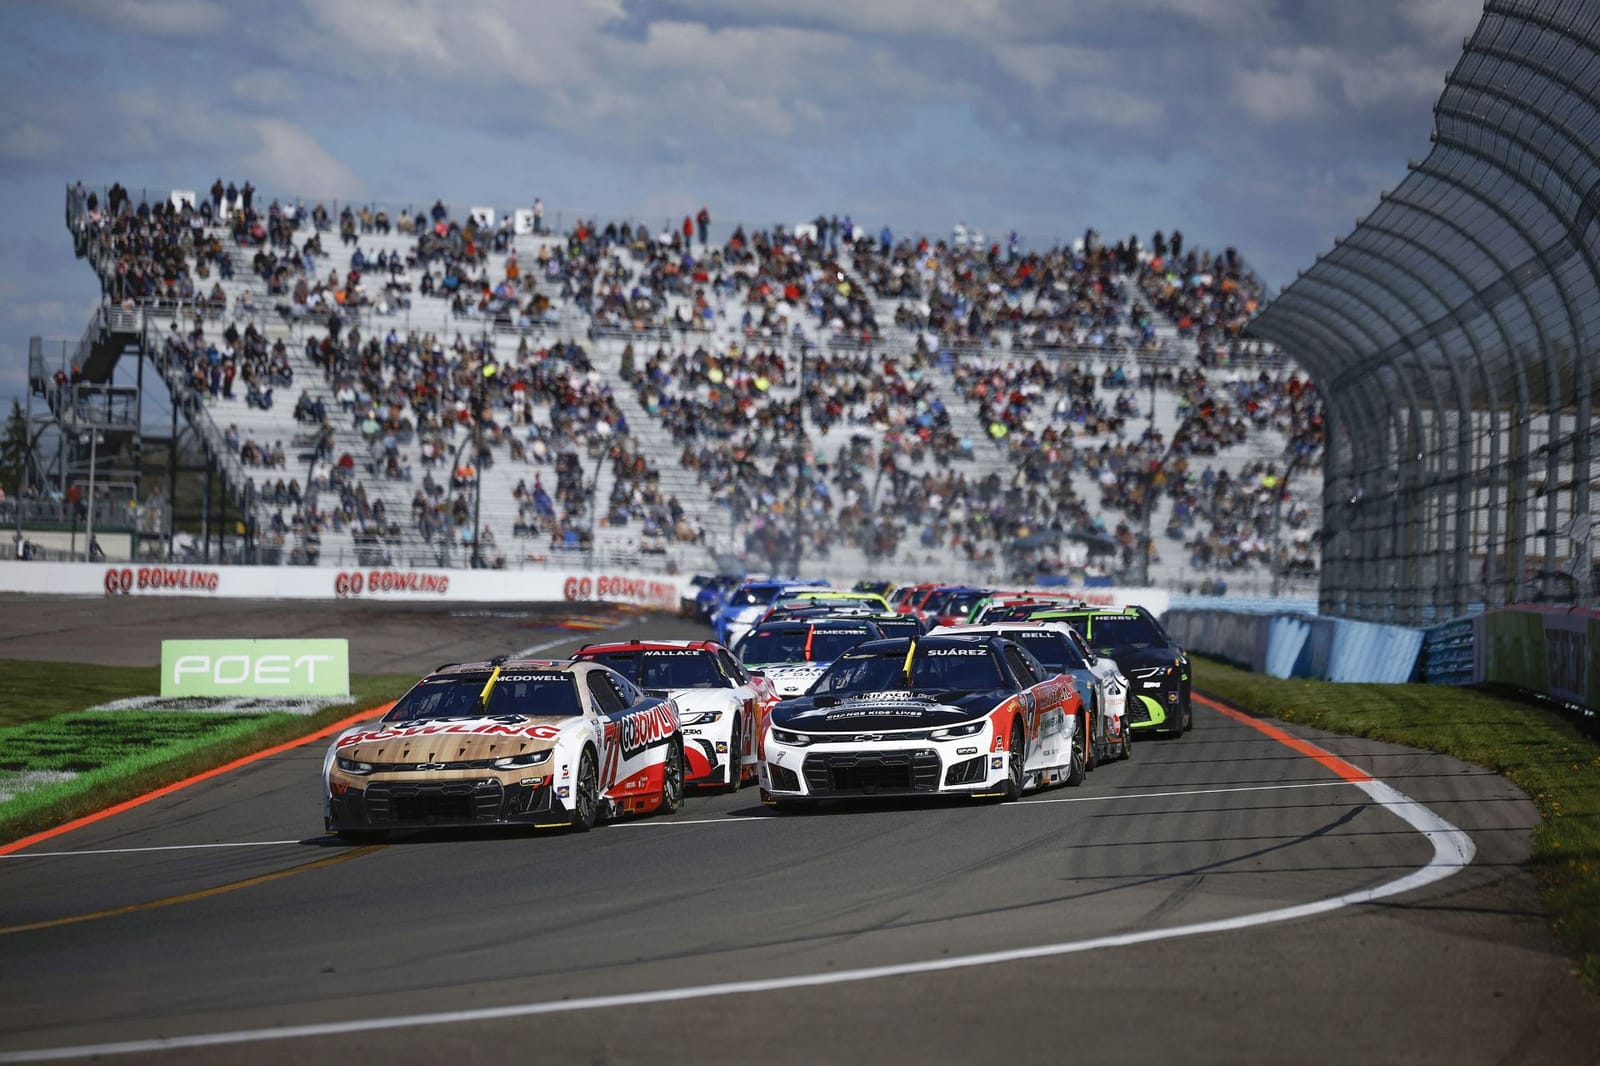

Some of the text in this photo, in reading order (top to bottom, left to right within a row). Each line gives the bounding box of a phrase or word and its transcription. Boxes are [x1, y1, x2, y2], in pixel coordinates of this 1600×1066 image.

[104, 567, 219, 594] GO BOWLING
[335, 570, 450, 595] GO BOWLING
[564, 576, 592, 600] GO
[927, 648, 987, 656] SUÁREZ
[173, 655, 333, 685] POET
[495, 674, 569, 682] MCDOWELL
[336, 724, 562, 748] BOWLING
[600, 721, 621, 791] 71
